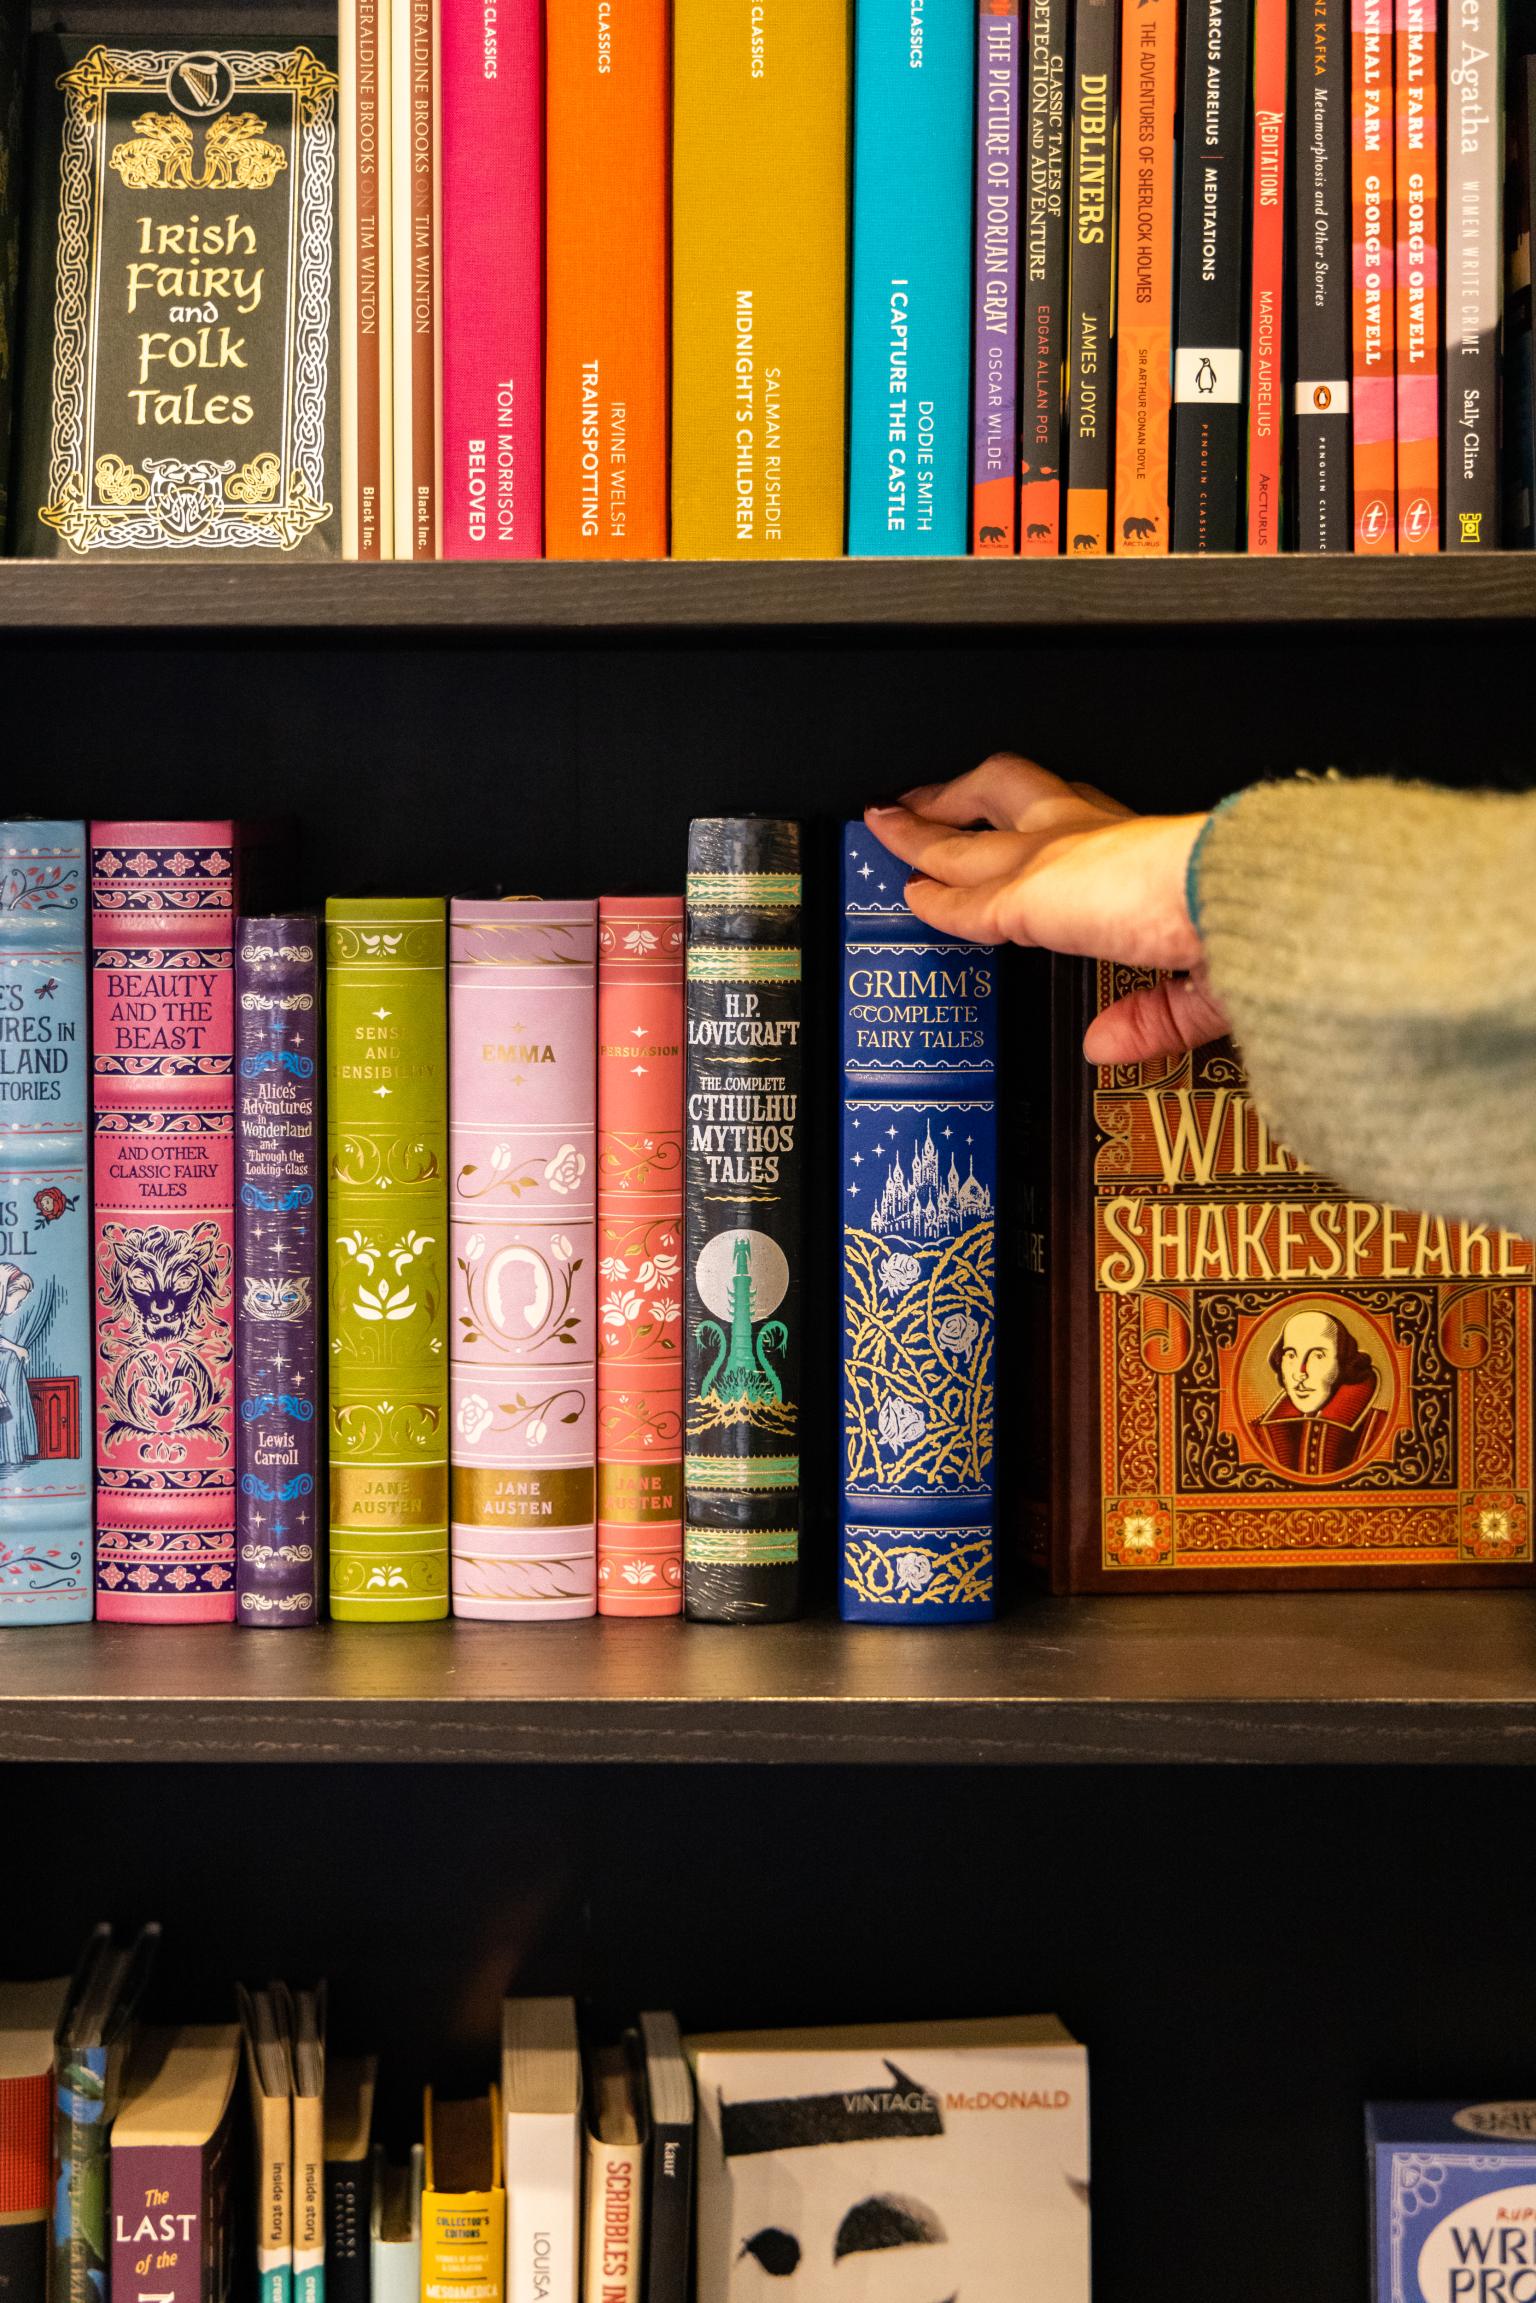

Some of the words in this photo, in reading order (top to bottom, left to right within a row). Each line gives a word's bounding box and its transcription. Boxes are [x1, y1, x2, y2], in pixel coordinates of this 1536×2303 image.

[360, 0, 375, 94] ERALDINE
[414, 0, 429, 93] ERALDINE
[484, 8, 497, 80] CLASSICS
[598, 3, 610, 74] CLASSICS
[751, 7, 764, 78] CLASSICS
[910, 0, 923, 68] CLASSICS
[987, 22, 1011, 63] THE
[1140, 21, 1156, 48] THE
[1314, 23, 1327, 76] KAFKA
[1049, 55, 1064, 128] CLASSIC
[1138, 52, 1156, 142] ADVENTURES
[1206, 66, 1220, 146] AURELIUS
[1451, 41, 1490, 155] Agatha
[988, 69, 1010, 156] PICTURE
[1365, 89, 1380, 151] FARM
[1408, 87, 1424, 150] FARM
[360, 102, 375, 174] BROOKS
[415, 101, 429, 173] BROOKS
[1032, 118, 1044, 149] AND
[1310, 88, 1328, 188] Metamorphosis
[987, 162, 1009, 188] OF
[1048, 132, 1063, 191] TALES
[1078, 73, 1107, 245] DUBLINERS
[1138, 148, 1154, 164] OF
[1256, 110, 1284, 206] MEDITATIONS
[361, 180, 375, 208] ON
[416, 179, 429, 208] ON
[1047, 194, 1061, 217] OF
[1137, 170, 1154, 242] SHERLOCK
[1314, 191, 1328, 216] and
[1461, 181, 1481, 238] WOMEN
[361, 215, 375, 249] TIM
[415, 214, 429, 248] TIM
[984, 195, 1009, 274] DORIAN
[1030, 154, 1048, 282] ADVENTURE
[1202, 168, 1218, 281] MEDITATIONS
[1365, 176, 1380, 267] GEORGE
[1409, 174, 1424, 266] GEORGE
[1314, 219, 1329, 260] Other
[1136, 246, 1153, 304] HOLMES
[1315, 262, 1329, 307] Stories
[1461, 247, 1480, 297] WRITE
[169, 302, 218, 323] and
[361, 255, 375, 334] WINTON
[416, 255, 430, 334] WINTON
[983, 280, 1008, 334] GRAY
[1037, 305, 1050, 355] EDGAR
[1259, 291, 1273, 355] MARCUS
[1365, 274, 1381, 365] ORWELL
[1409, 272, 1424, 363] ORWELL
[1461, 305, 1480, 356] CRIME
[736, 290, 753, 422] MIDNIGHT'S
[889, 293, 908, 393] CAPTURE
[1081, 312, 1097, 375] JAMES
[1138, 349, 1147, 365] SIR
[987, 347, 1003, 408] OSCAR
[1036, 359, 1049, 410] ALLAN
[1138, 368, 1147, 408] ARTHUR
[497, 380, 513, 427] TONI
[765, 368, 781, 449] SALMAN
[1080, 381, 1096, 438] JOYCE
[1257, 360, 1272, 437] AURELIUS
[1459, 390, 1480, 428] Sally
[611, 402, 625, 464] IRVINE
[889, 399, 907, 442] THE
[917, 401, 934, 465] DODIE
[1035, 414, 1048, 445] POE
[1137, 410, 1147, 447] CONAN
[582, 360, 598, 537] TRAINSPOTTING
[987, 414, 1002, 471] WILDE
[1463, 433, 1480, 480] Cline
[736, 429, 753, 539] CHILDREN
[1136, 449, 1146, 480] DOYLE
[363, 487, 374, 523] Black
[418, 486, 429, 523] Black
[469, 440, 485, 541] BELOVED
[498, 435, 513, 541] MORRISON
[611, 471, 625, 537] WELSH
[765, 456, 781, 540] RUSHDIE
[887, 448, 905, 531] CASTLE
[917, 472, 933, 531] SMITH
[1258, 473, 1271, 546] ARCTURUS
[363, 526, 374, 550] Inc.
[418, 526, 429, 550] Inc.
[108, 975, 218, 998] BEAUTY
[849, 966, 992, 998] GRIMM'S
[111, 1004, 157, 1022] AND
[163, 1003, 212, 1021] THE
[726, 993, 760, 1018] H.P.
[849, 1005, 978, 1024] COMPLETE
[58, 1022, 75, 1041] IN
[116, 1027, 206, 1049] BEAST
[600, 1046, 679, 1057] PERSUASION
[688, 1020, 800, 1047] LOVECRAFT
[857, 1030, 914, 1048] FAIRY
[920, 1030, 984, 1048] TALES
[481, 1045, 556, 1064] EMMA
[258, 1081, 296, 1100] Alice's
[700, 1077, 722, 1091] THE
[724, 1077, 786, 1091] COMPLETE
[241, 1099, 313, 1116] Adventures
[258, 1114, 267, 1125] in
[689, 1094, 797, 1123] CTHULHU
[241, 1121, 313, 1138] Wonderland
[259, 1139, 276, 1150] and
[690, 1124, 794, 1153] MYTHOS
[110, 1165, 171, 1178] CLASSIC
[175, 1165, 219, 1178] FAIRY
[117, 1147, 149, 1160] AND
[151, 1147, 209, 1160] OTHER
[246, 1163, 308, 1177] Looking-Glass
[249, 1150, 288, 1163] Through
[289, 1150, 304, 1162] the
[706, 1156, 780, 1183] TALES
[139, 1183, 187, 1197] TALES
[1101, 1195, 1527, 1294] SHAKESPEARE
[254, 1450, 299, 1466] Carroll
[258, 1432, 295, 1447] Lewis
[364, 1482, 411, 1495] JANE
[495, 1482, 540, 1496] JANE
[606, 1495, 673, 1509] AUSTEN
[616, 1476, 662, 1491] JANE
[352, 1500, 422, 1514] AUSTEN
[483, 1501, 553, 1515] AUSTEN
[843, 2093, 936, 2113] VINTAGE
[947, 2091, 1070, 2110] McDONALD
[663, 2142, 680, 2178] kaur
[145, 2189, 169, 2207] The
[273, 2163, 284, 2201] inside
[306, 2164, 317, 2201] inside
[116, 2215, 196, 2242] LAST
[271, 2204, 282, 2241] story
[305, 2205, 315, 2241] story
[603, 2161, 632, 2277] SCRIBBLES
[136, 2254, 152, 2275] of
[157, 2252, 177, 2269] the
[533, 2232, 550, 2301] LOUISA
